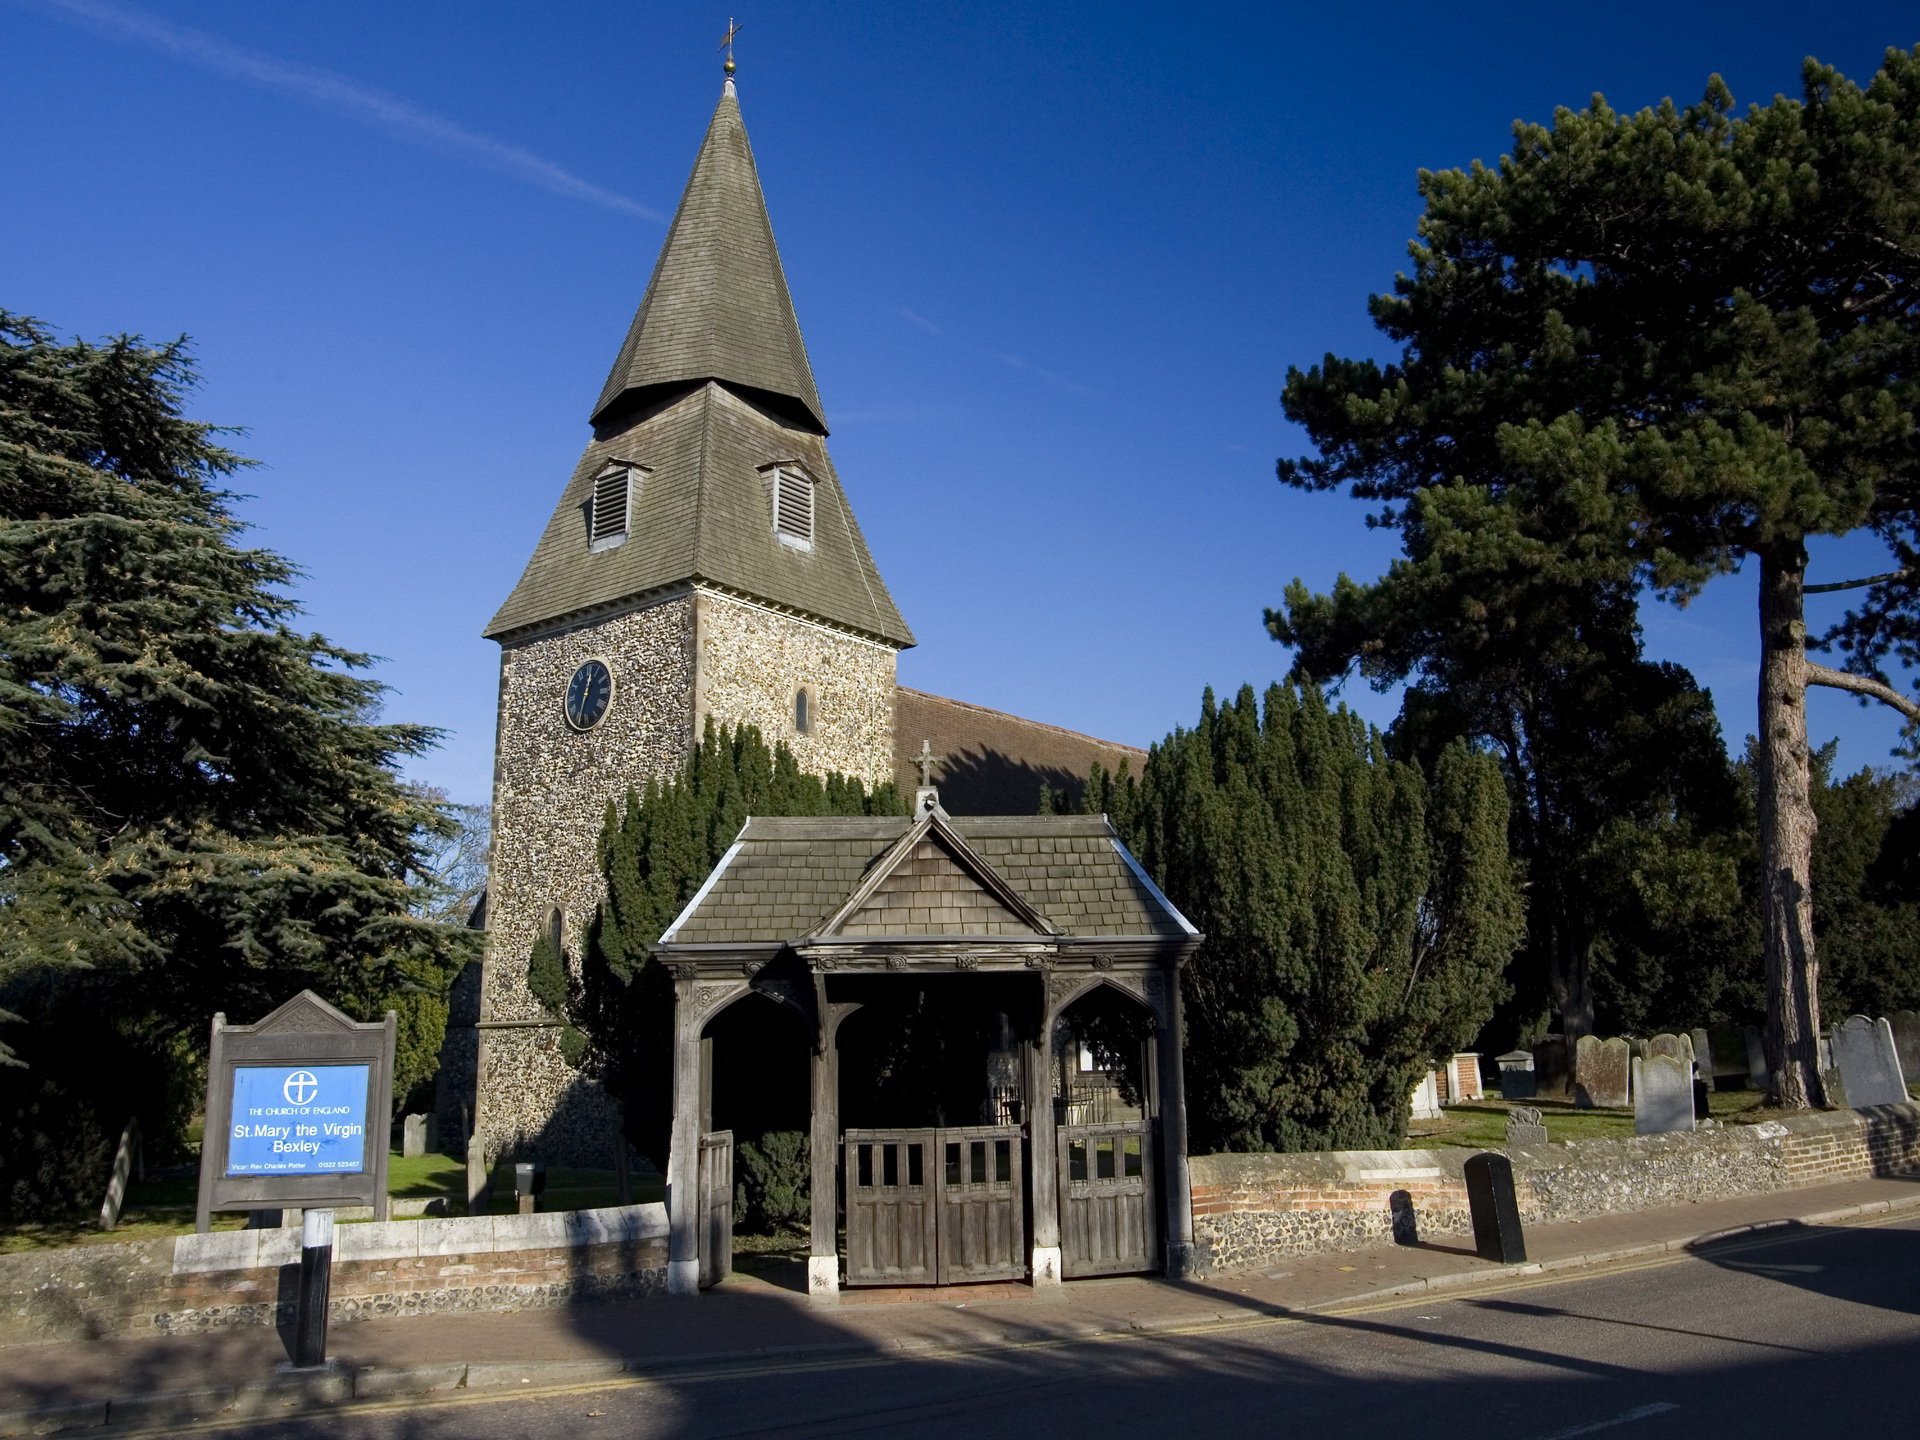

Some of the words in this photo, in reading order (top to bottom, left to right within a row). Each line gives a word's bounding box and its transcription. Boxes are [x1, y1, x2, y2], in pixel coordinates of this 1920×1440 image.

[249, 1108, 263, 1116] THE
[265, 1107, 298, 1115] CHURCH
[300, 1107, 310, 1115] OF
[313, 1106, 350, 1114] ENGLAND
[296, 1123, 318, 1136] the
[323, 1122, 362, 1138] Virgin
[273, 1140, 320, 1155] Bexley
